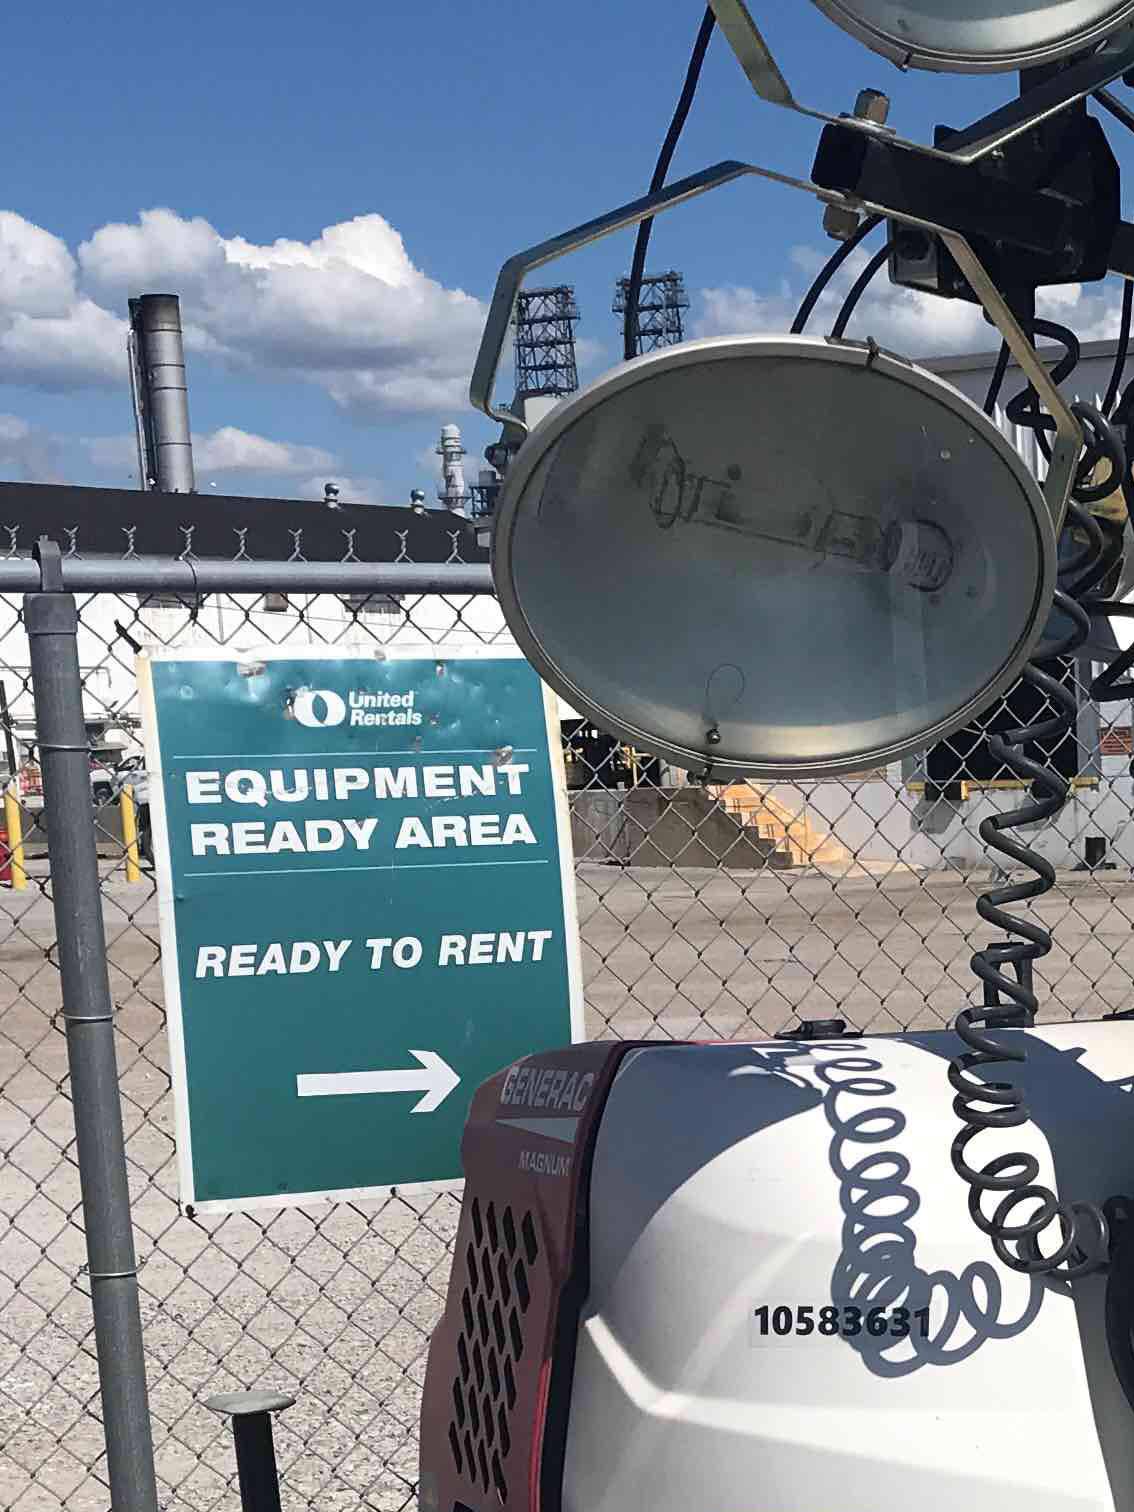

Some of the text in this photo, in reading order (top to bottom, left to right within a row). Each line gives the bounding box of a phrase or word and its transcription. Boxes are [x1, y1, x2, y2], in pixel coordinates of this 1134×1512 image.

[349, 689, 414, 708] United
[350, 708, 423, 726] Rentals
[185, 763, 530, 808] EQUIPMENT
[191, 814, 538, 857] READY AREA
[195, 930, 553, 979] READY TO RENT
[500, 1066, 595, 1112] GENERAC
[519, 1151, 575, 1177] MAGNUM
[753, 1304, 931, 1338] 10583631
